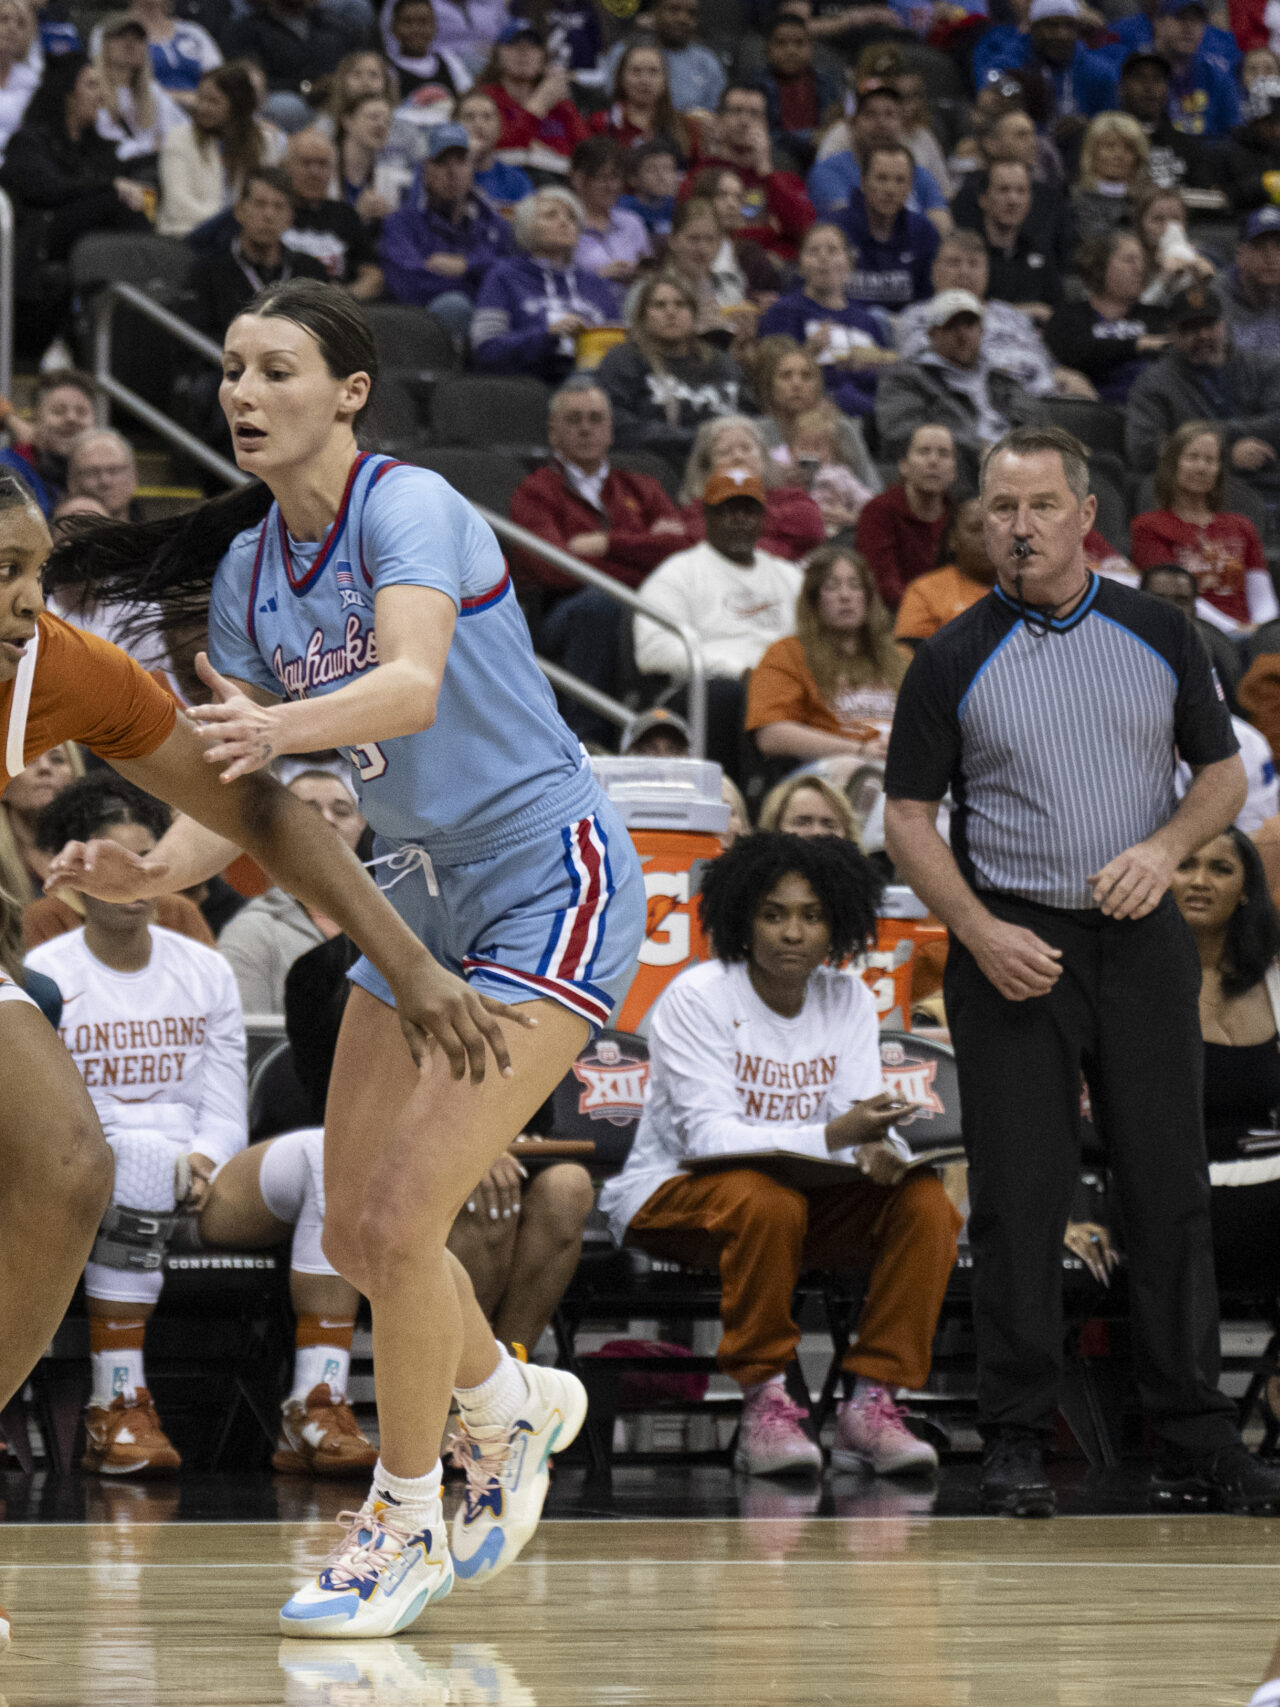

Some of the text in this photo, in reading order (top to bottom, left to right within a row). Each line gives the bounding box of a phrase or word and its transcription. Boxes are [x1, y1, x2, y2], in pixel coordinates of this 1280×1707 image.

[637, 871, 690, 967] G
[83, 1052, 188, 1087] ENERGY
[577, 1067, 647, 1107] XII
[168, 1257, 276, 1270] CONFERENCE
